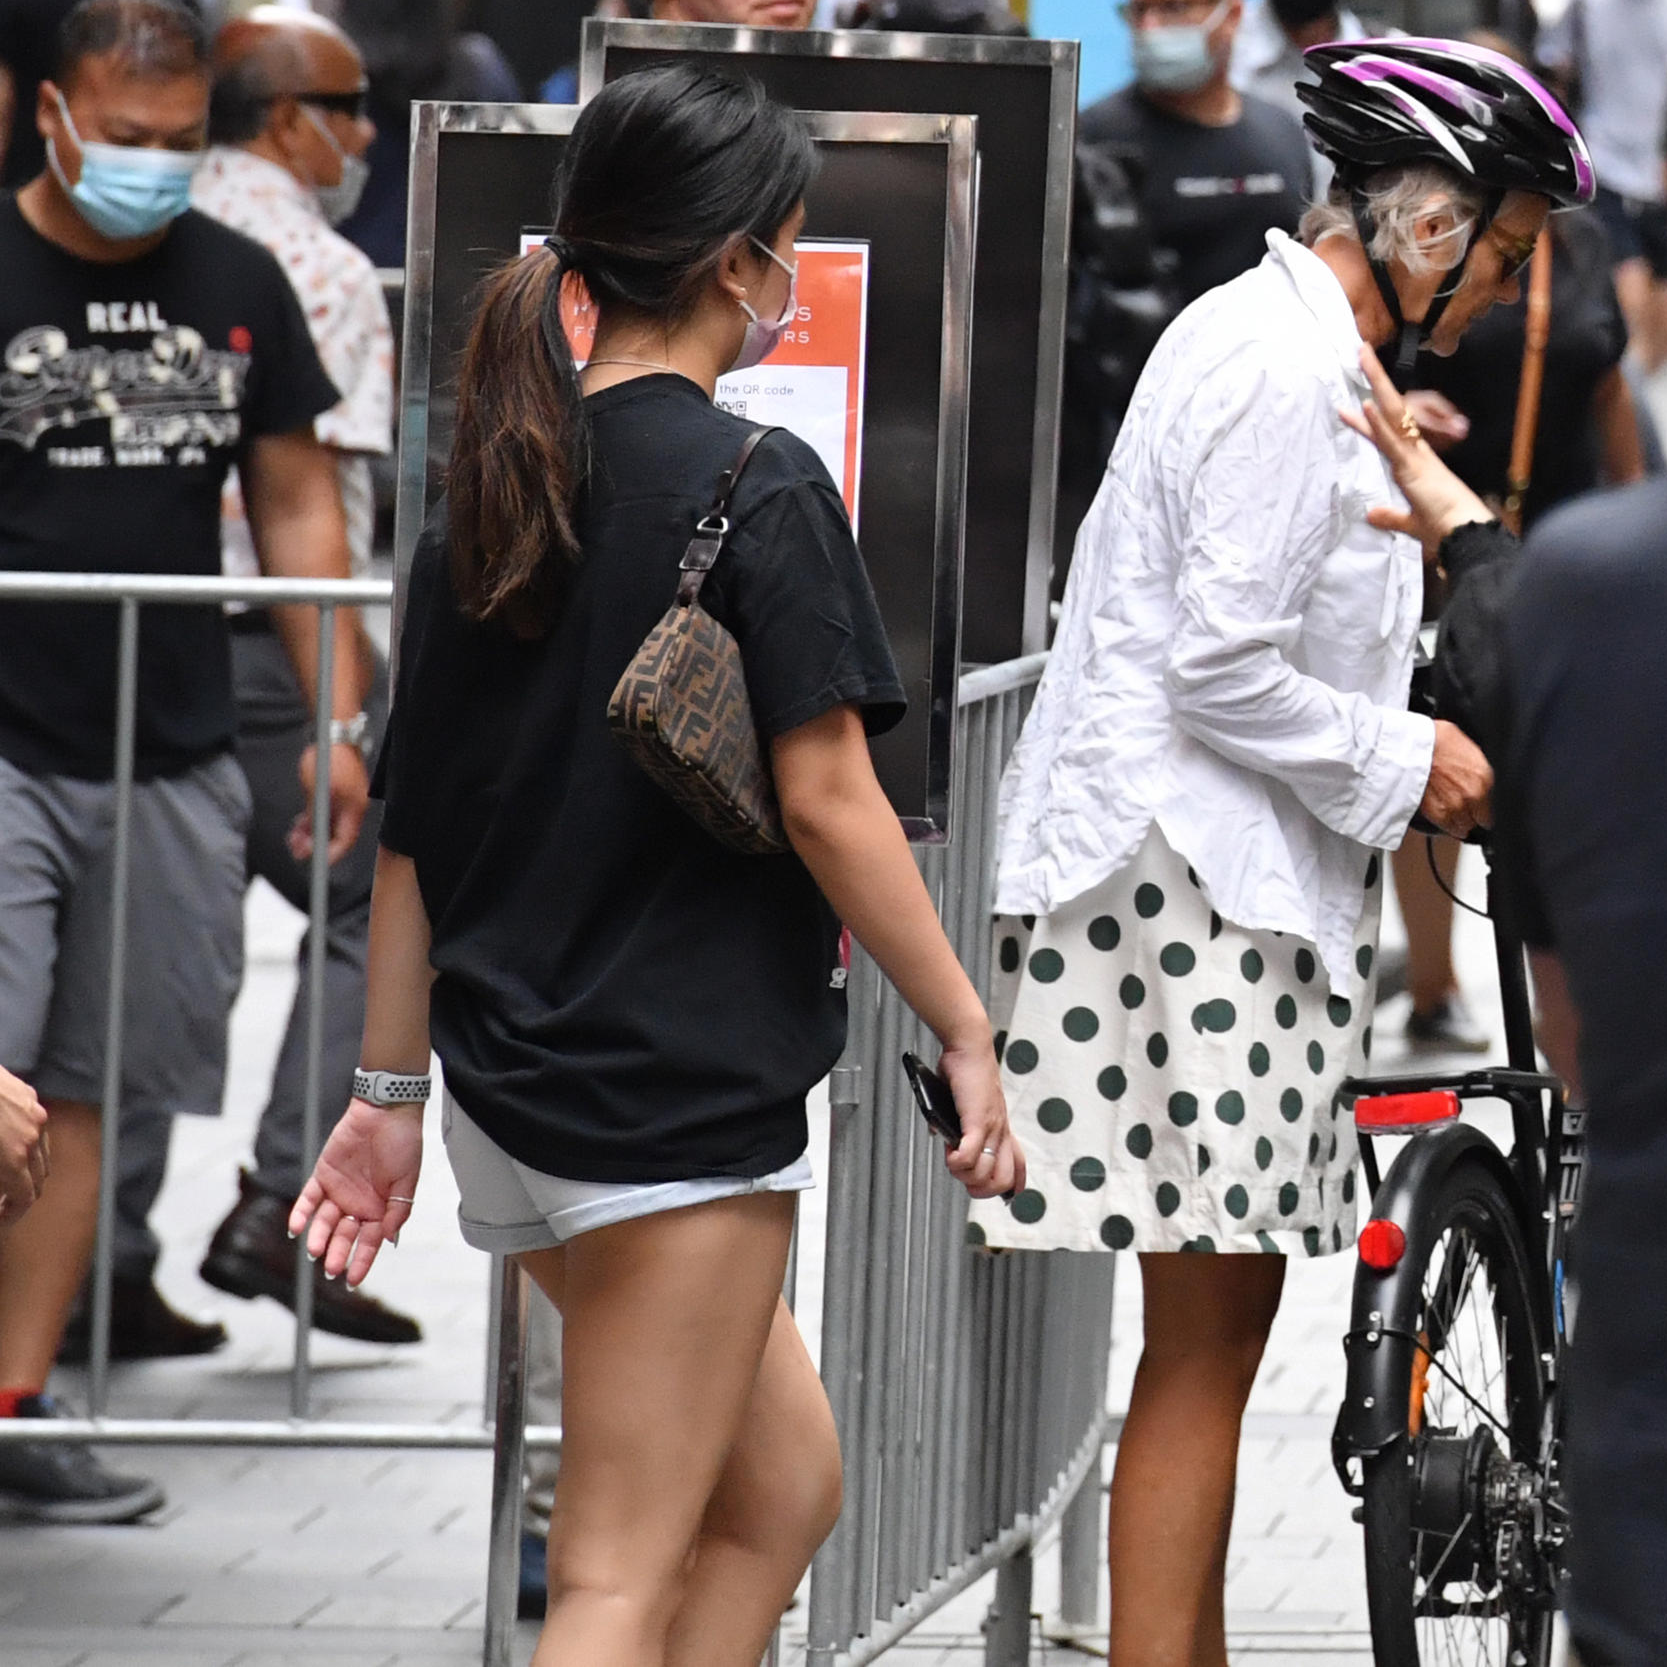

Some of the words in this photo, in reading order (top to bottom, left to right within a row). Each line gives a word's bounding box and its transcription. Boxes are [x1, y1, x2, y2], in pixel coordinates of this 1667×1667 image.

[85, 300, 169, 334] REAL
[719, 384, 739, 395] the
[742, 385, 761, 395] QR
[764, 385, 795, 396] code
